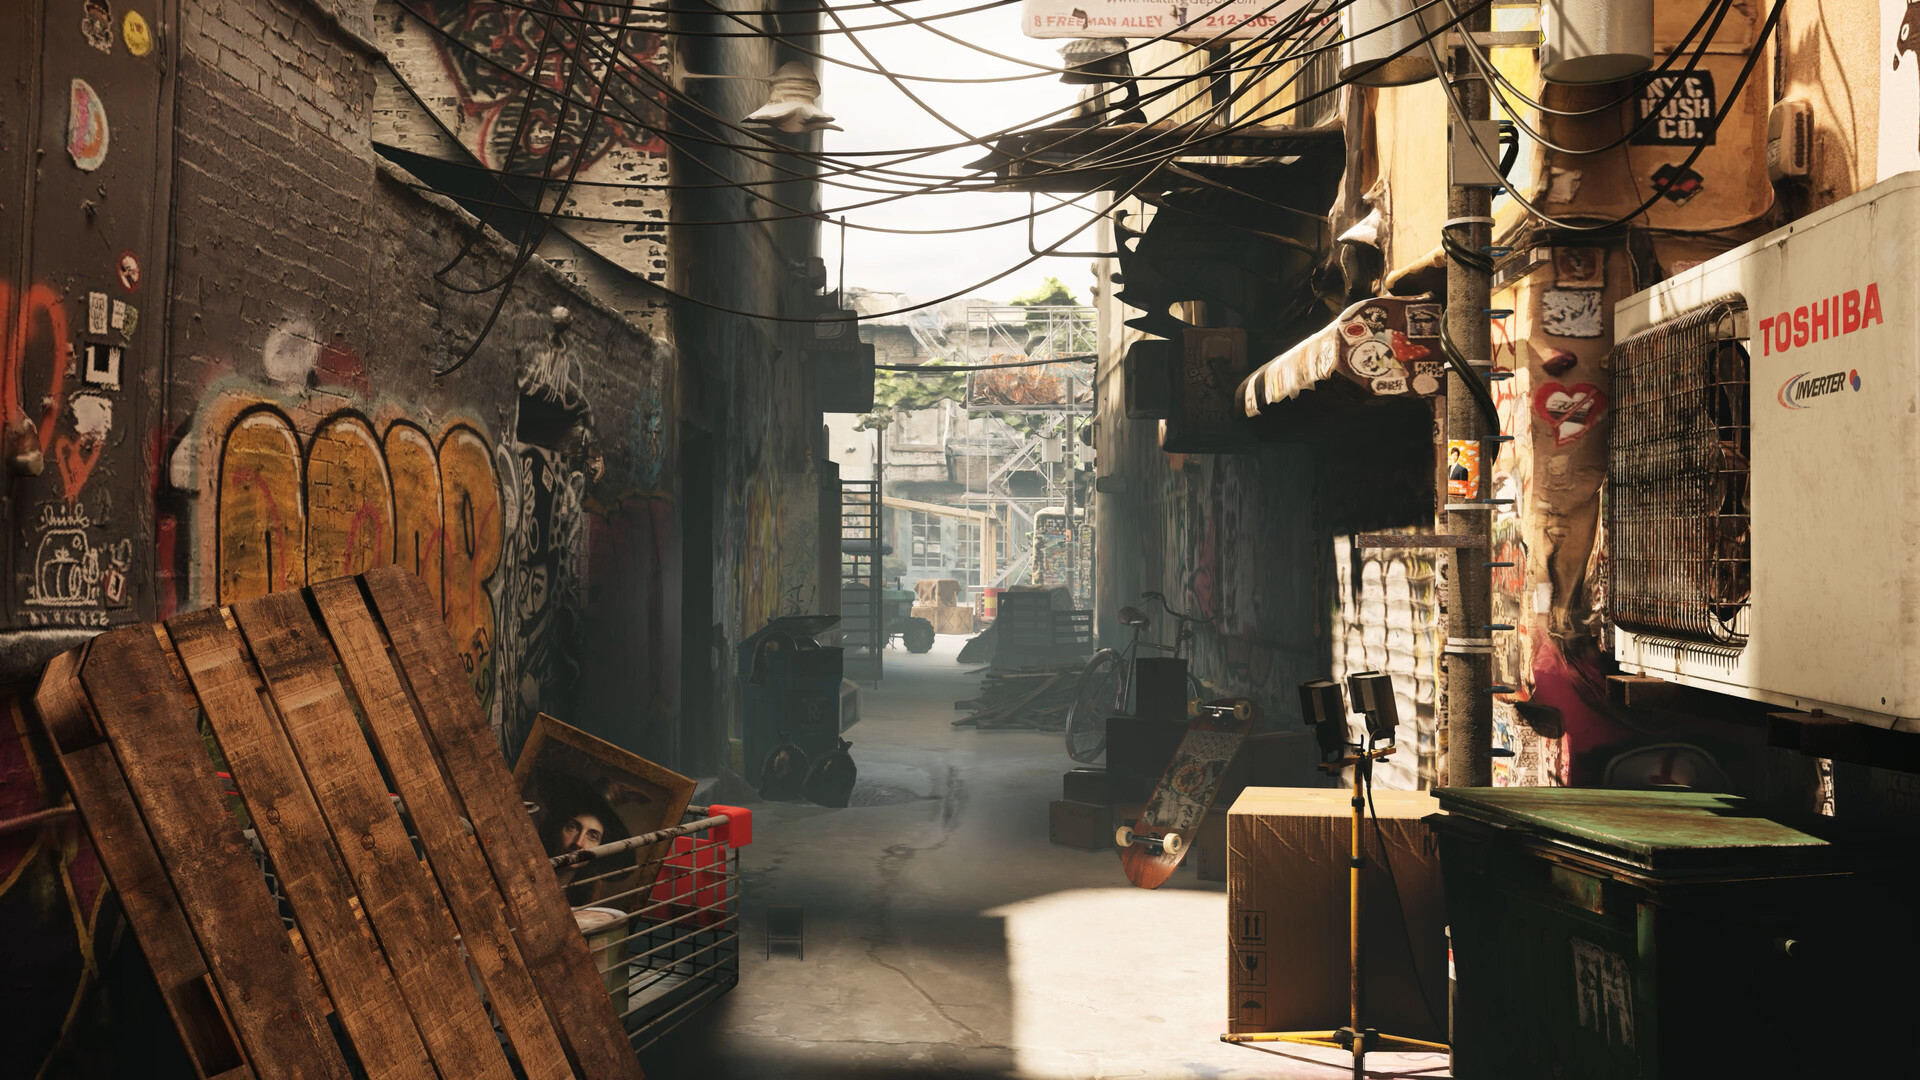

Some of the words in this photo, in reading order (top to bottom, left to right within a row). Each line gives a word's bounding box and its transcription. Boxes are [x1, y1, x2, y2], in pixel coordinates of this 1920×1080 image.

[1046, 15, 1117, 27] FREEMAN
[1121, 15, 1163, 28] ALLEY
[1646, 76, 1704, 98] NYC
[1640, 98, 1710, 119] KUSH
[1658, 119, 1704, 139] CO.
[1759, 282, 1883, 357] TOSHIBA
[1795, 371, 1846, 400] INVERTER
